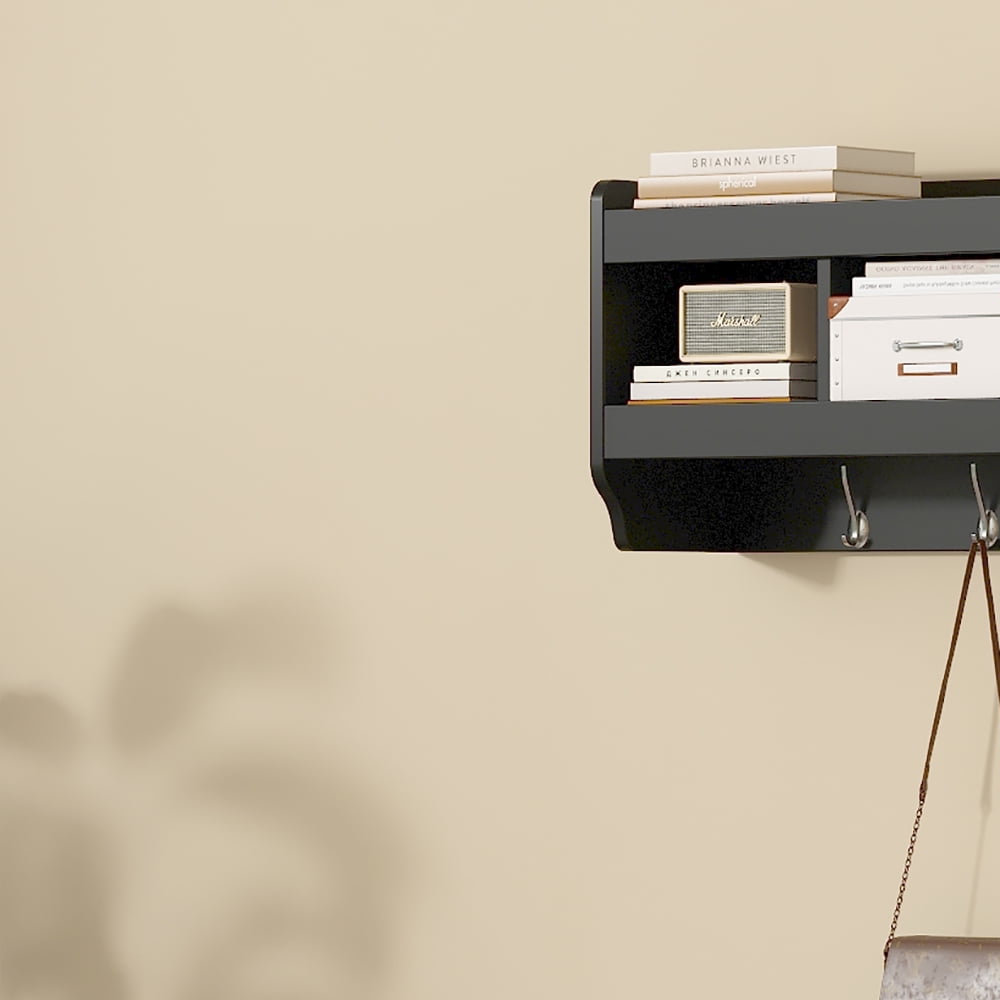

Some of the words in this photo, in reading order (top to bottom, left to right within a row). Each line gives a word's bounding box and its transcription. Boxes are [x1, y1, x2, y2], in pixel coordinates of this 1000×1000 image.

[692, 156, 751, 168] BRIANNA
[758, 153, 797, 165] WIEST
[719, 175, 758, 191] spherical
[710, 311, 761, 328] Marshall
[666, 369, 697, 378] ДЖЕН
[706, 368, 760, 376] СИНСЕРО
